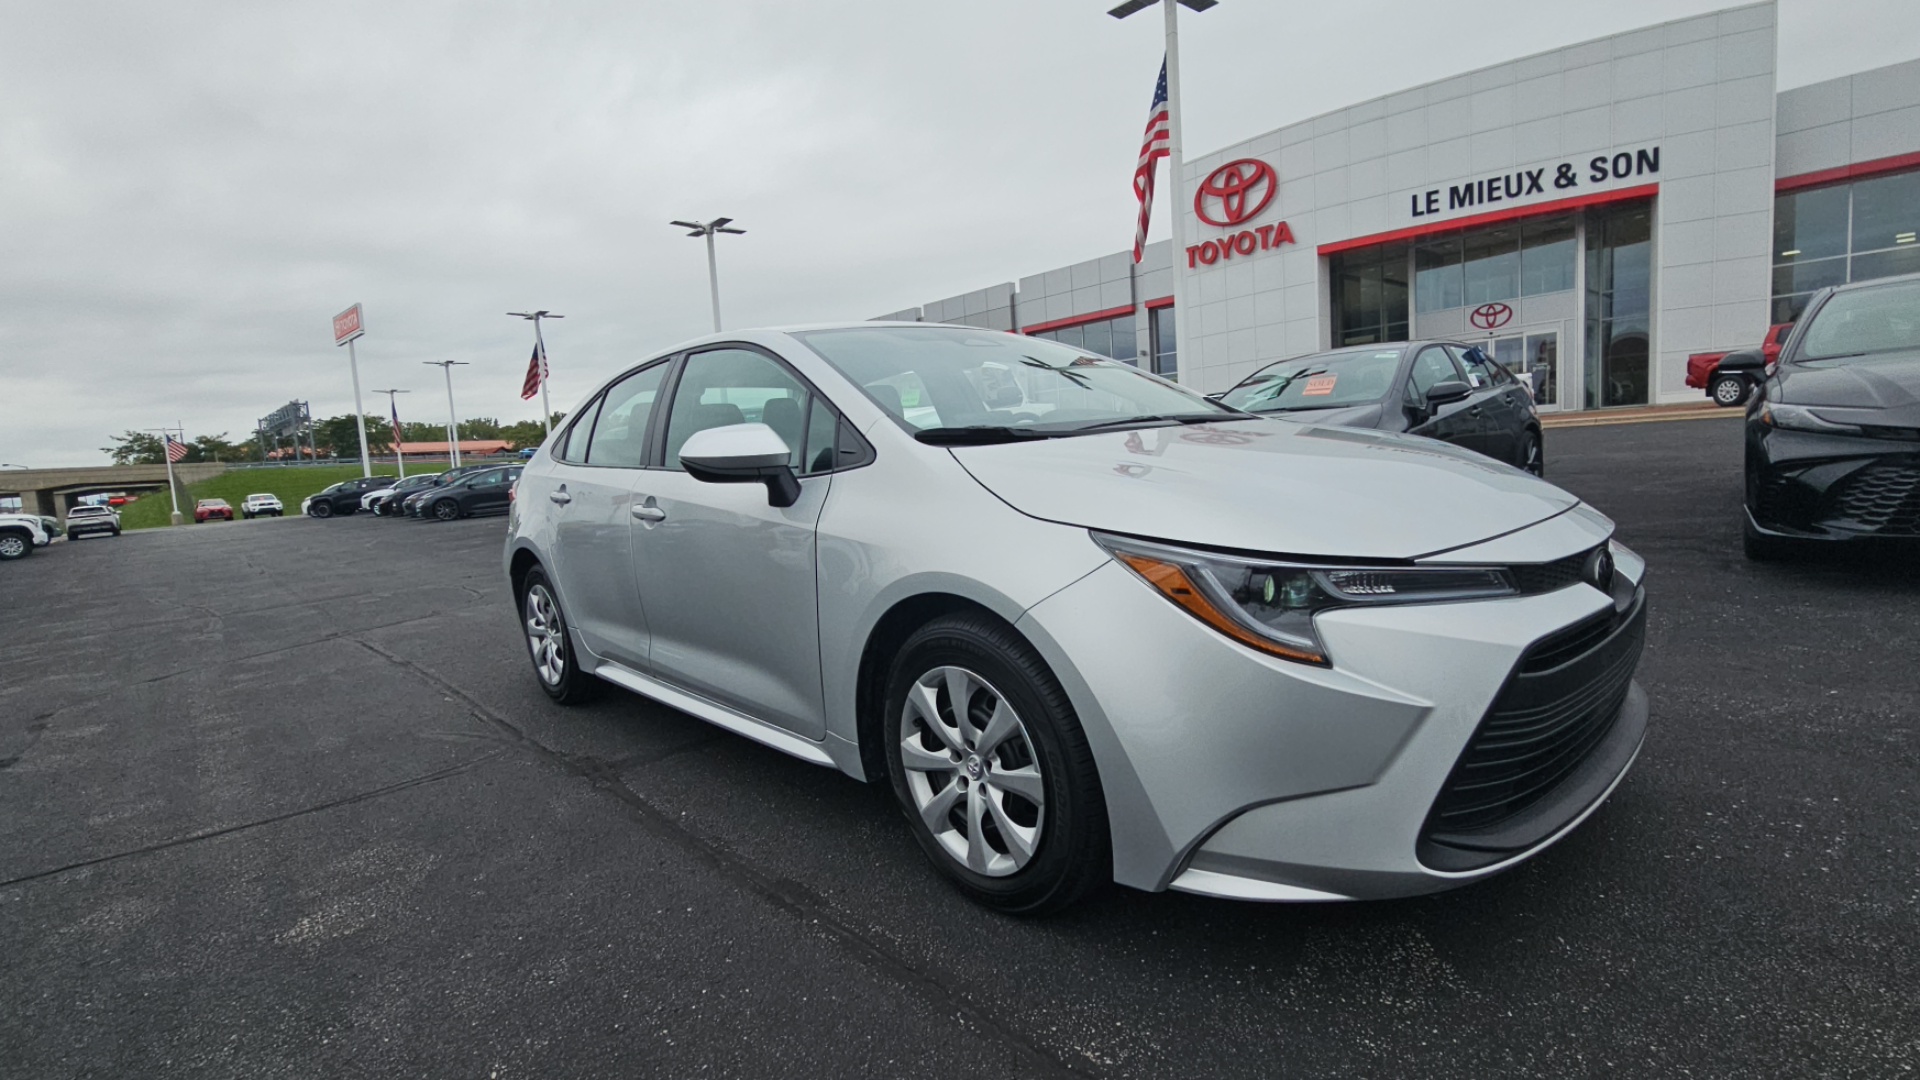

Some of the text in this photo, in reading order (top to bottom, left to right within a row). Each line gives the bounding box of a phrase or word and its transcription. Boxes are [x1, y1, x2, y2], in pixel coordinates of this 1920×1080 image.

[1411, 146, 1660, 217] LE MIEUX & SON
[1185, 221, 1296, 269] TOYOTA
